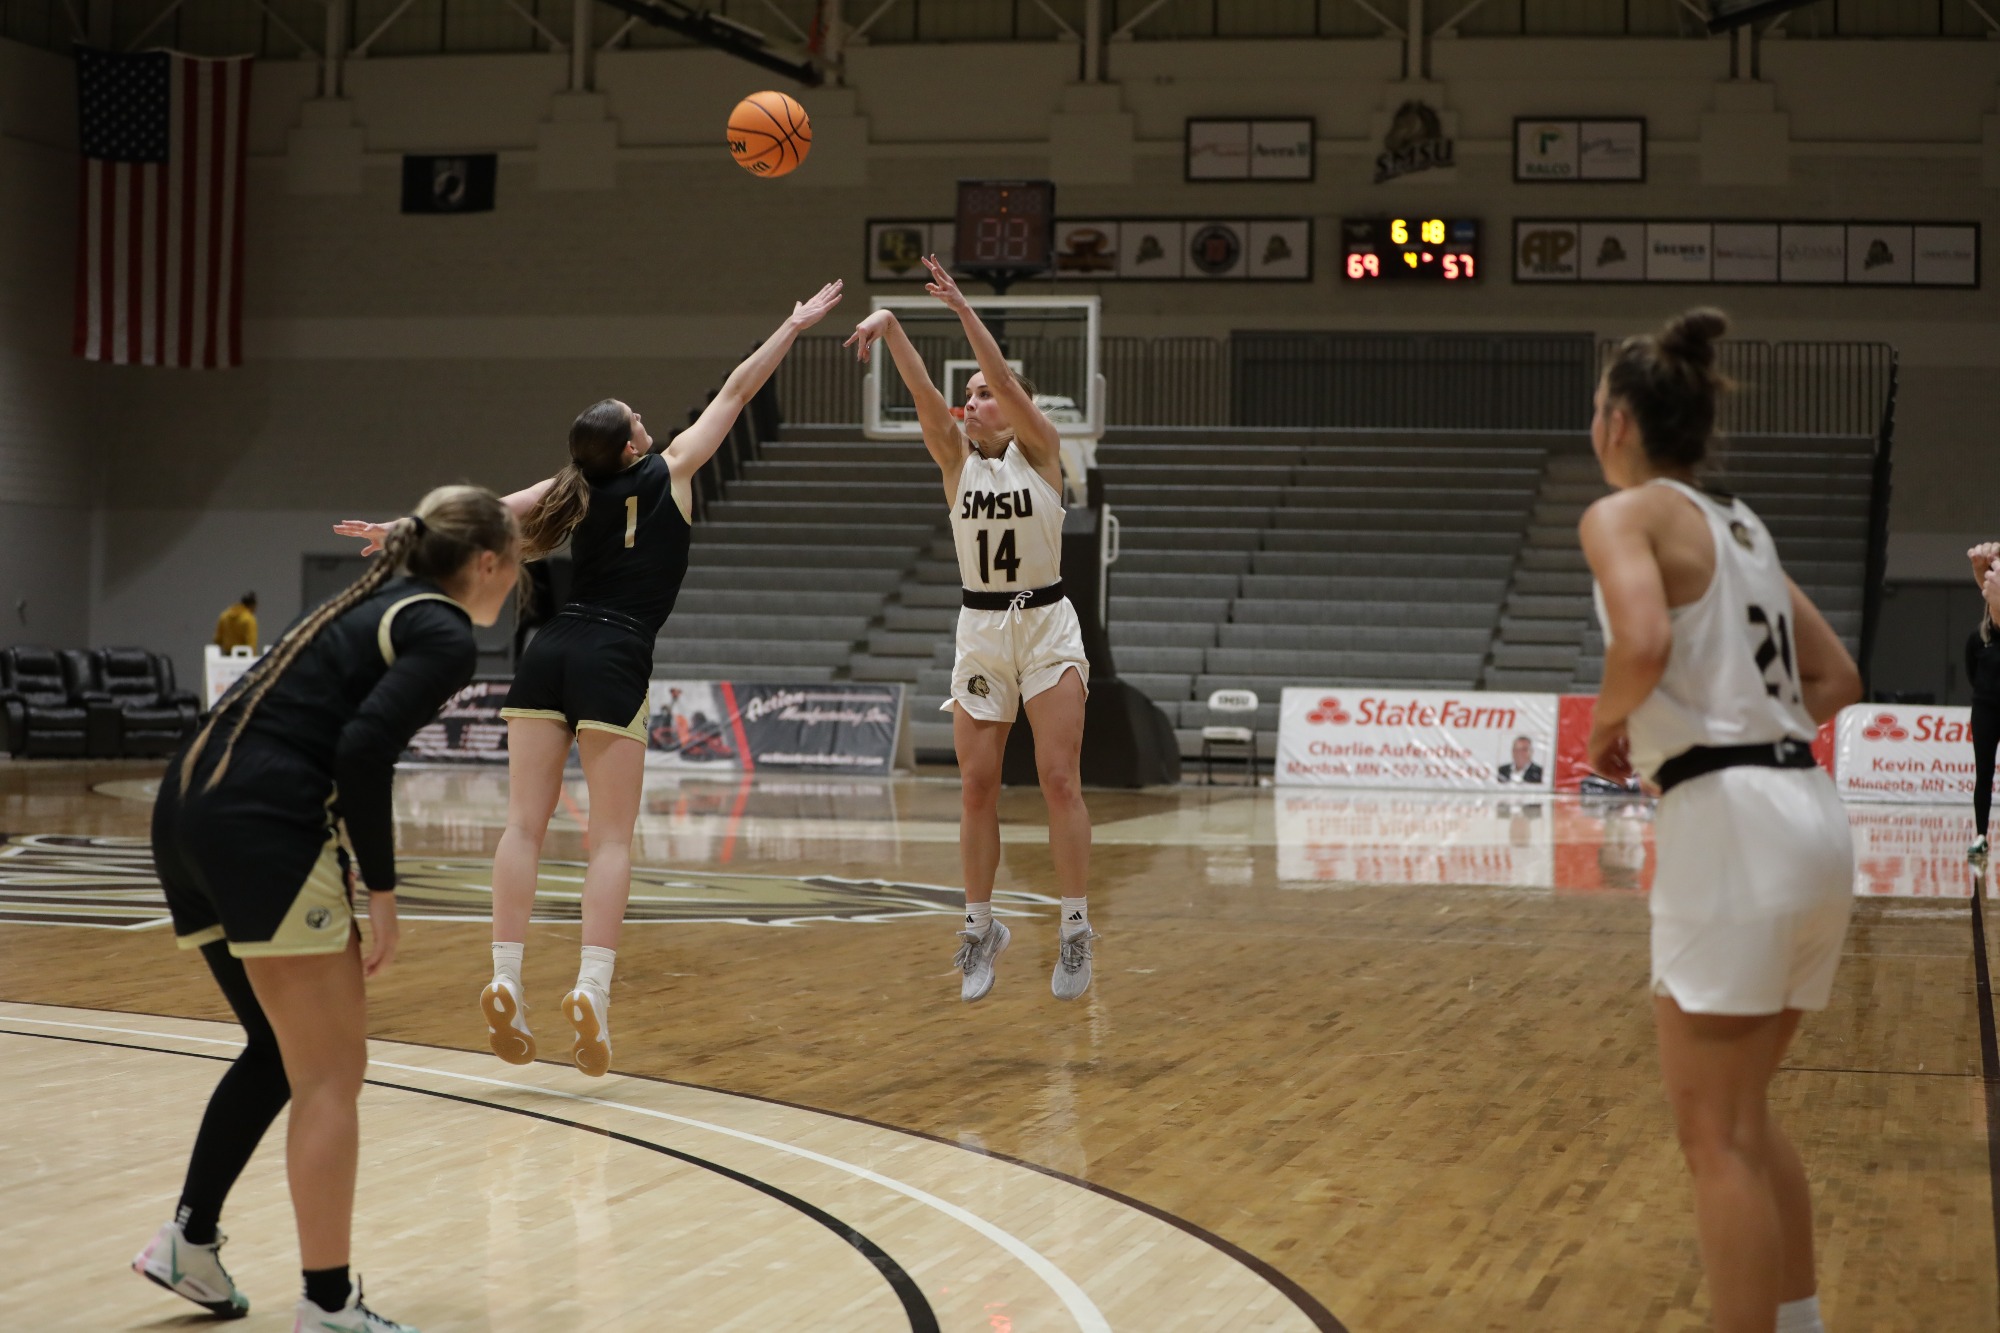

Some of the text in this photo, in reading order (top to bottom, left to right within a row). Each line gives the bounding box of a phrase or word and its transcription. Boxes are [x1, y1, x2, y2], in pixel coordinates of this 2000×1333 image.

[1374, 137, 1455, 184] SMSU
[1525, 162, 1571, 175] RALCO
[1391, 219, 1446, 244] 6 18
[1521, 229, 1575, 268] AP
[1347, 253, 1380, 279] 69
[1442, 253, 1474, 279] 57
[961, 488, 1033, 520] SMSU
[624, 495, 638, 549] 1
[976, 529, 1022, 584] 14
[745, 689, 805, 722] Action
[1913, 715, 1974, 743] Stat
[1308, 741, 1375, 757] Charlie
[1873, 757, 1925, 772] Kevin
[1848, 777, 1918, 792] Minneota,
[1921, 779, 1944, 791] MN
